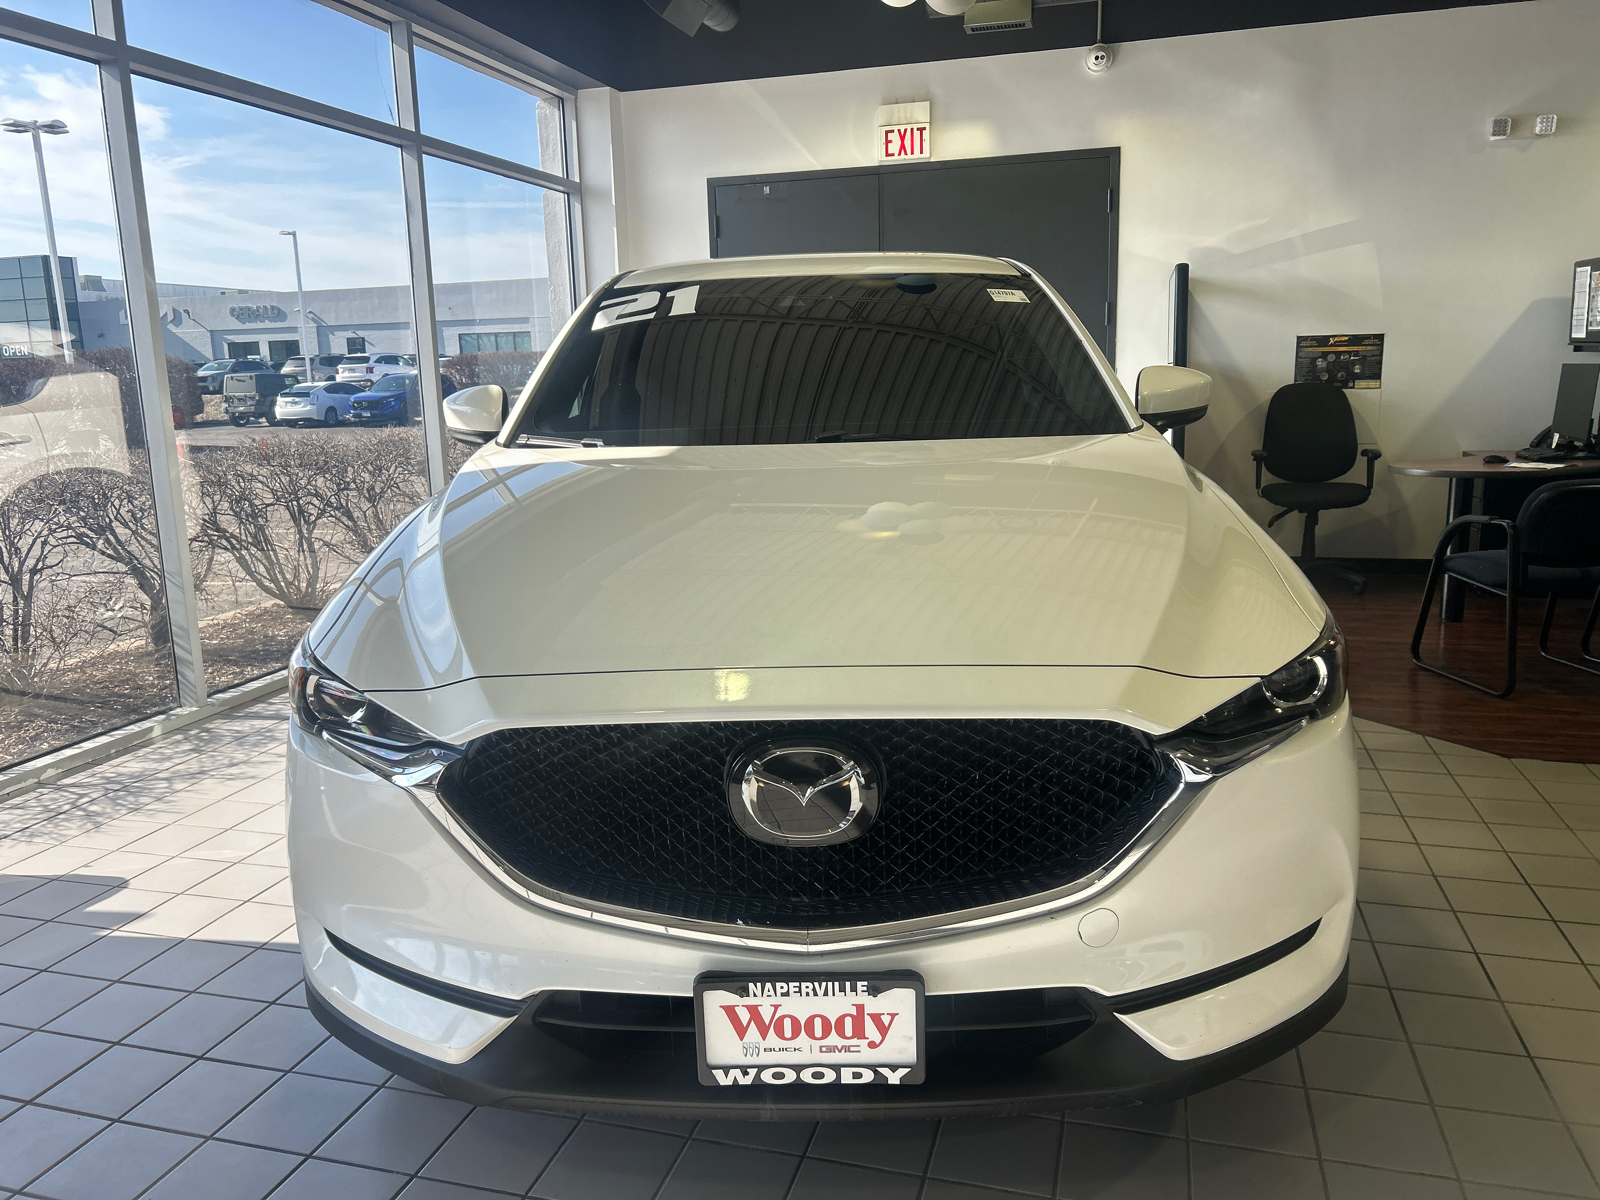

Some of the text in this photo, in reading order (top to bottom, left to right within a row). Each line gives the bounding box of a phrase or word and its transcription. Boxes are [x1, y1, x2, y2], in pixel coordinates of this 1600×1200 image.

[884, 127, 927, 157] EXIT
[228, 303, 279, 320] GERALD
[591, 285, 700, 331] 21
[2, 345, 28, 356] OPEN
[748, 981, 868, 997] NAPERVILLE
[719, 1004, 899, 1049] Woody
[819, 1045, 861, 1053] GMC
[711, 1067, 912, 1085] WOODY
